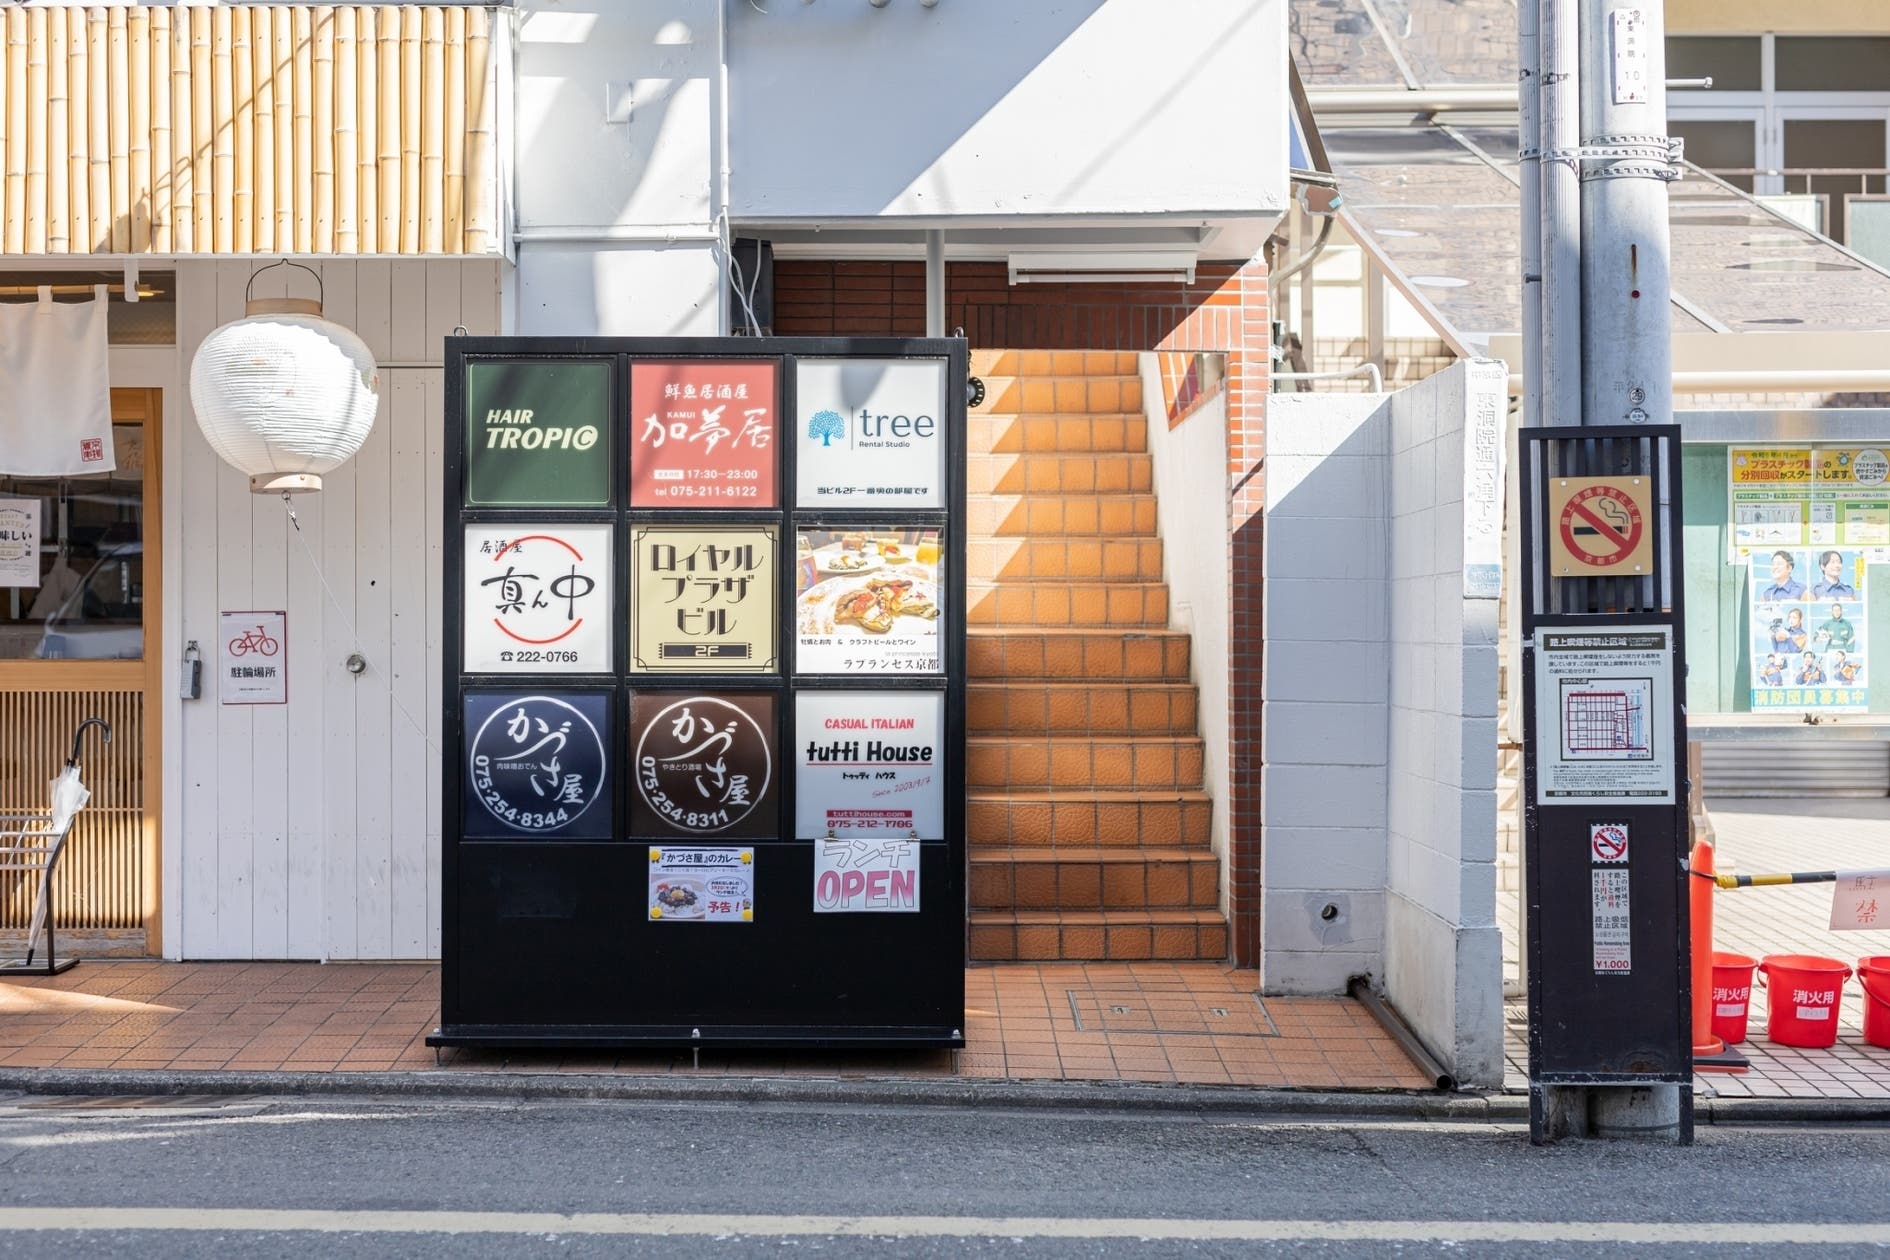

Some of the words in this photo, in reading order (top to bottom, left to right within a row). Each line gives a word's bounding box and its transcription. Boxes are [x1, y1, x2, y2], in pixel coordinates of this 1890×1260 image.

[1625, 71, 1640, 81] 10
[665, 383, 749, 399] 鮮魚居酒屋
[486, 409, 534, 424] HAIR
[667, 411, 696, 419] KAMUI
[640, 404, 773, 456] 加夢居
[859, 409, 935, 438] tree
[671, 486, 757, 497] 075-211-6122
[480, 539, 523, 554] 居酒屋
[651, 544, 764, 571] ロイヤル
[480, 564, 595, 621] 真ん中
[661, 574, 755, 604] プラザ
[677, 607, 737, 636] ビル
[516, 651, 578, 662] 222-0766
[694, 645, 720, 657] 2F
[230, 666, 276, 678] 駐輪場所
[1755, 690, 1865, 705] 消防団員募集中
[825, 718, 868, 729] CASUAL
[871, 718, 915, 729] ITALIAN
[493, 707, 584, 804] かづさ屋
[657, 707, 751, 805] かづさ屋
[806, 741, 859, 761] tutti
[866, 741, 933, 761] House
[662, 763, 702, 771] やきとり酒場
[875, 771, 896, 780] ハウス
[822, 840, 911, 868] ランチ
[816, 870, 915, 910] OPEN
[1855, 898, 1878, 923] 禁
[1712, 986, 1750, 1002] 消火用
[1792, 988, 1835, 1004] 消火用
